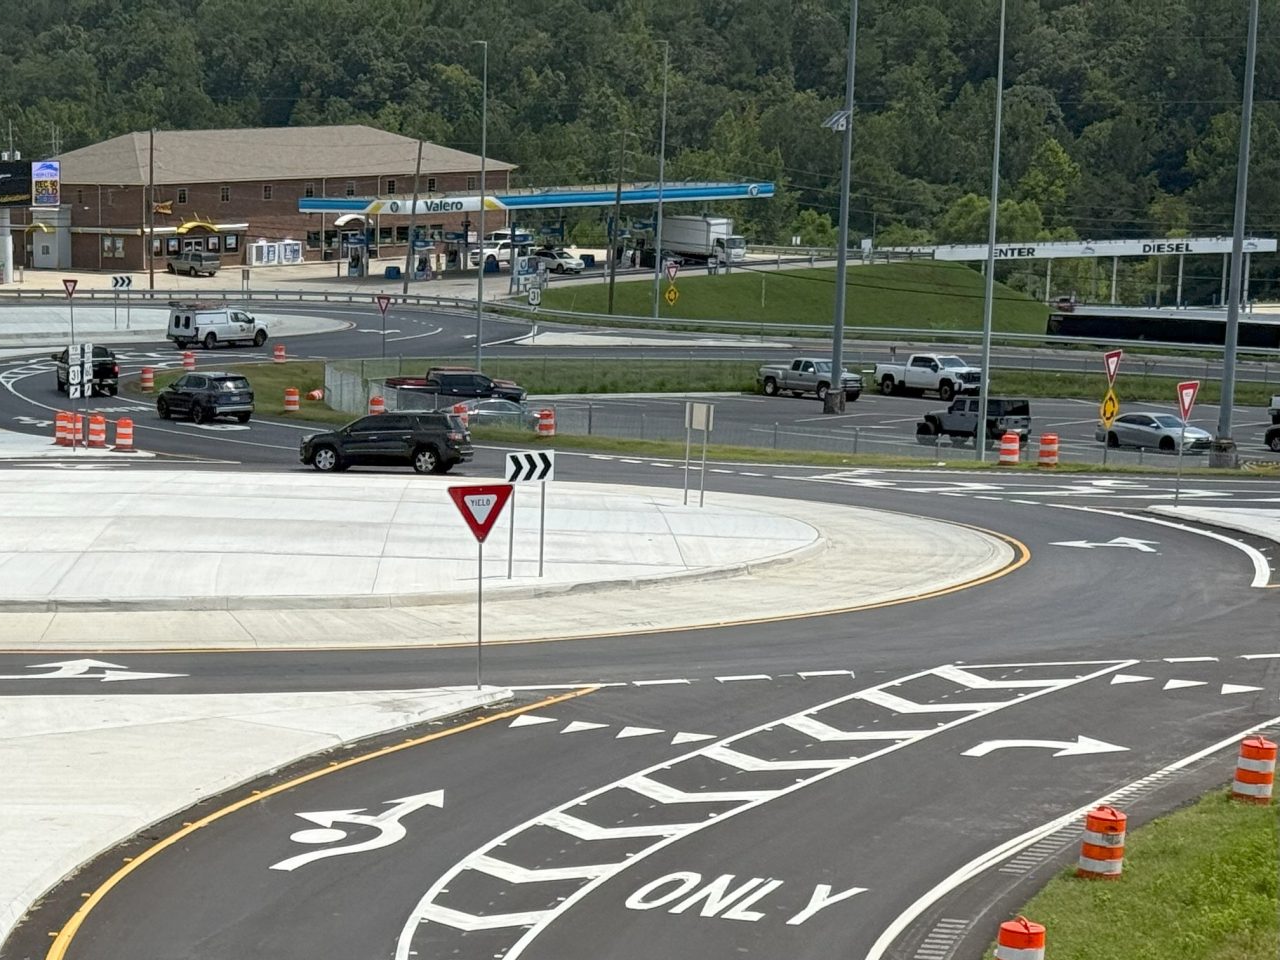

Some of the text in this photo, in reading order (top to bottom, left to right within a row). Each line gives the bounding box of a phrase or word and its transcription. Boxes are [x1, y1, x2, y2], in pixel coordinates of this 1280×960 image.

[424, 200, 463, 212] Valero
[993, 247, 1035, 257] ENTER
[1142, 242, 1193, 253] DIESEL
[531, 291, 539, 301] 31
[71, 369, 79, 380] 31
[470, 498, 490, 506] YIELD
[625, 871, 869, 925] ONLY
